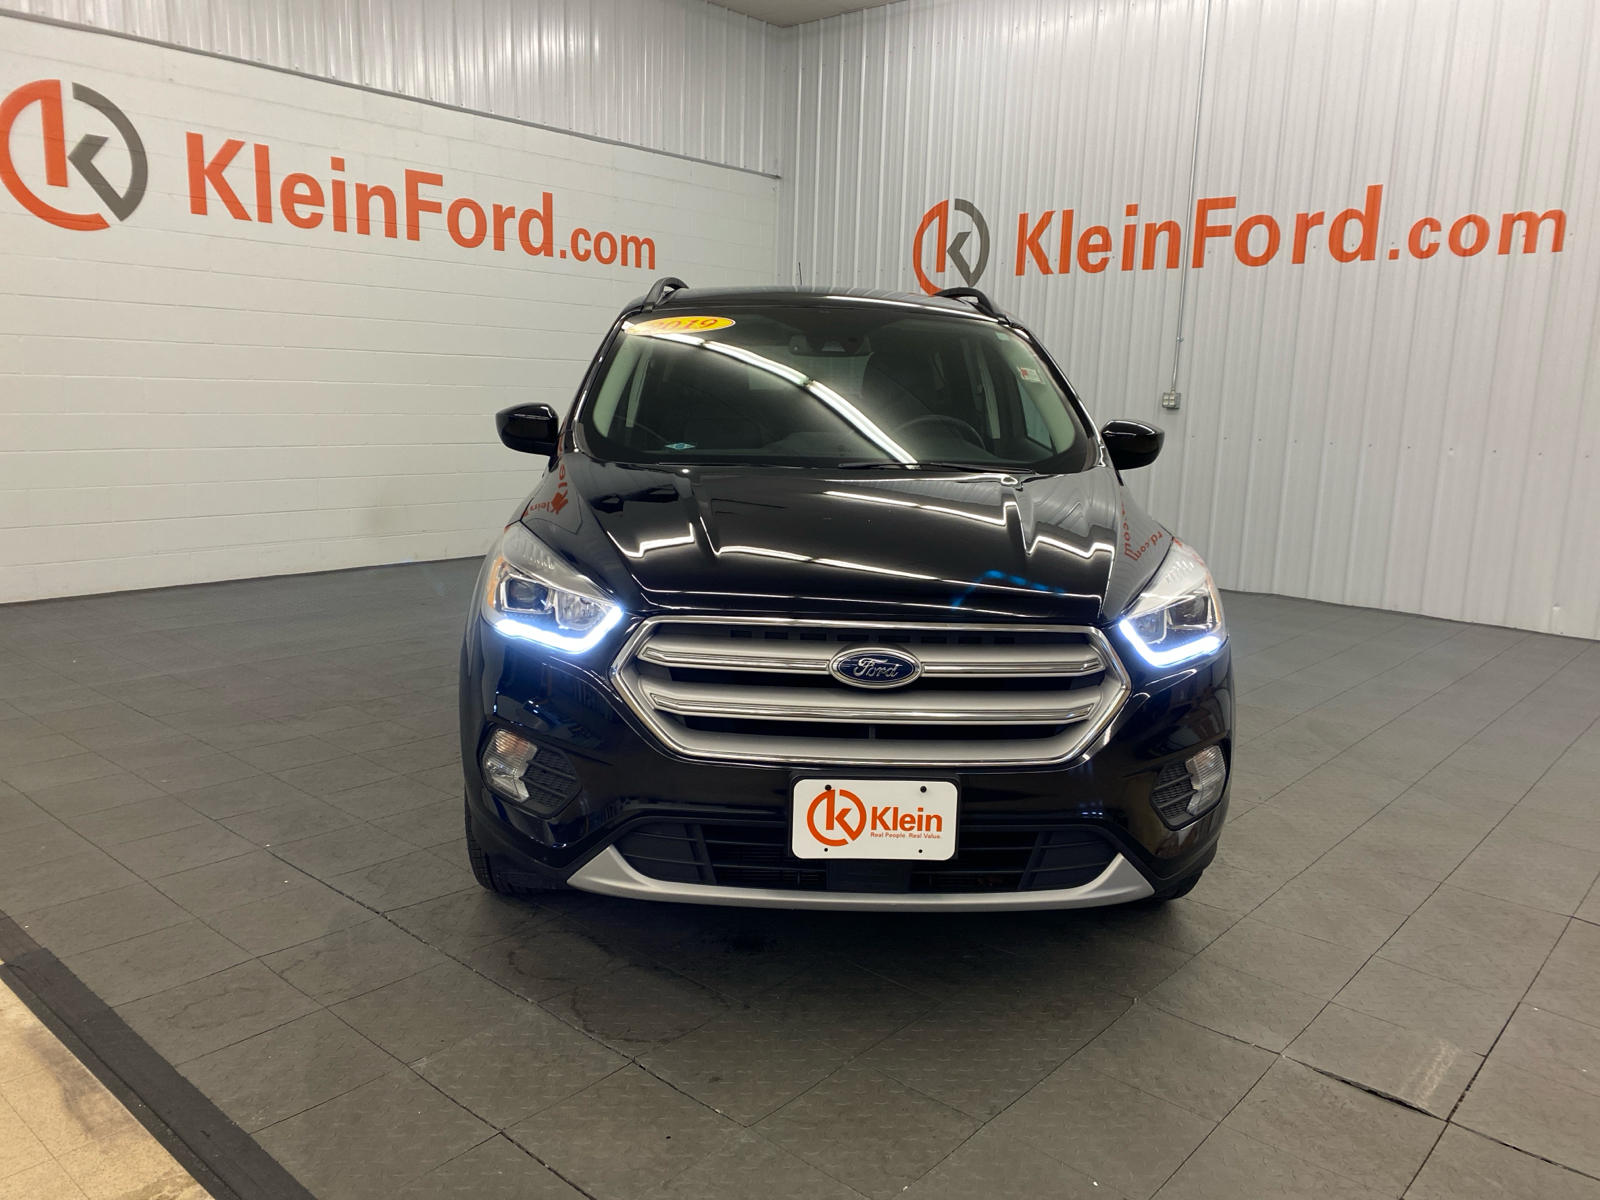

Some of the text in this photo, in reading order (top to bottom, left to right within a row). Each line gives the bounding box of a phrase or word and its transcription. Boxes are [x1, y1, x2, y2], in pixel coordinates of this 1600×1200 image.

[186, 131, 656, 271] KleinFord.com
[1015, 184, 1567, 277] KleinFord.com
[853, 657, 903, 678] Ford
[870, 806, 943, 832] Klein
